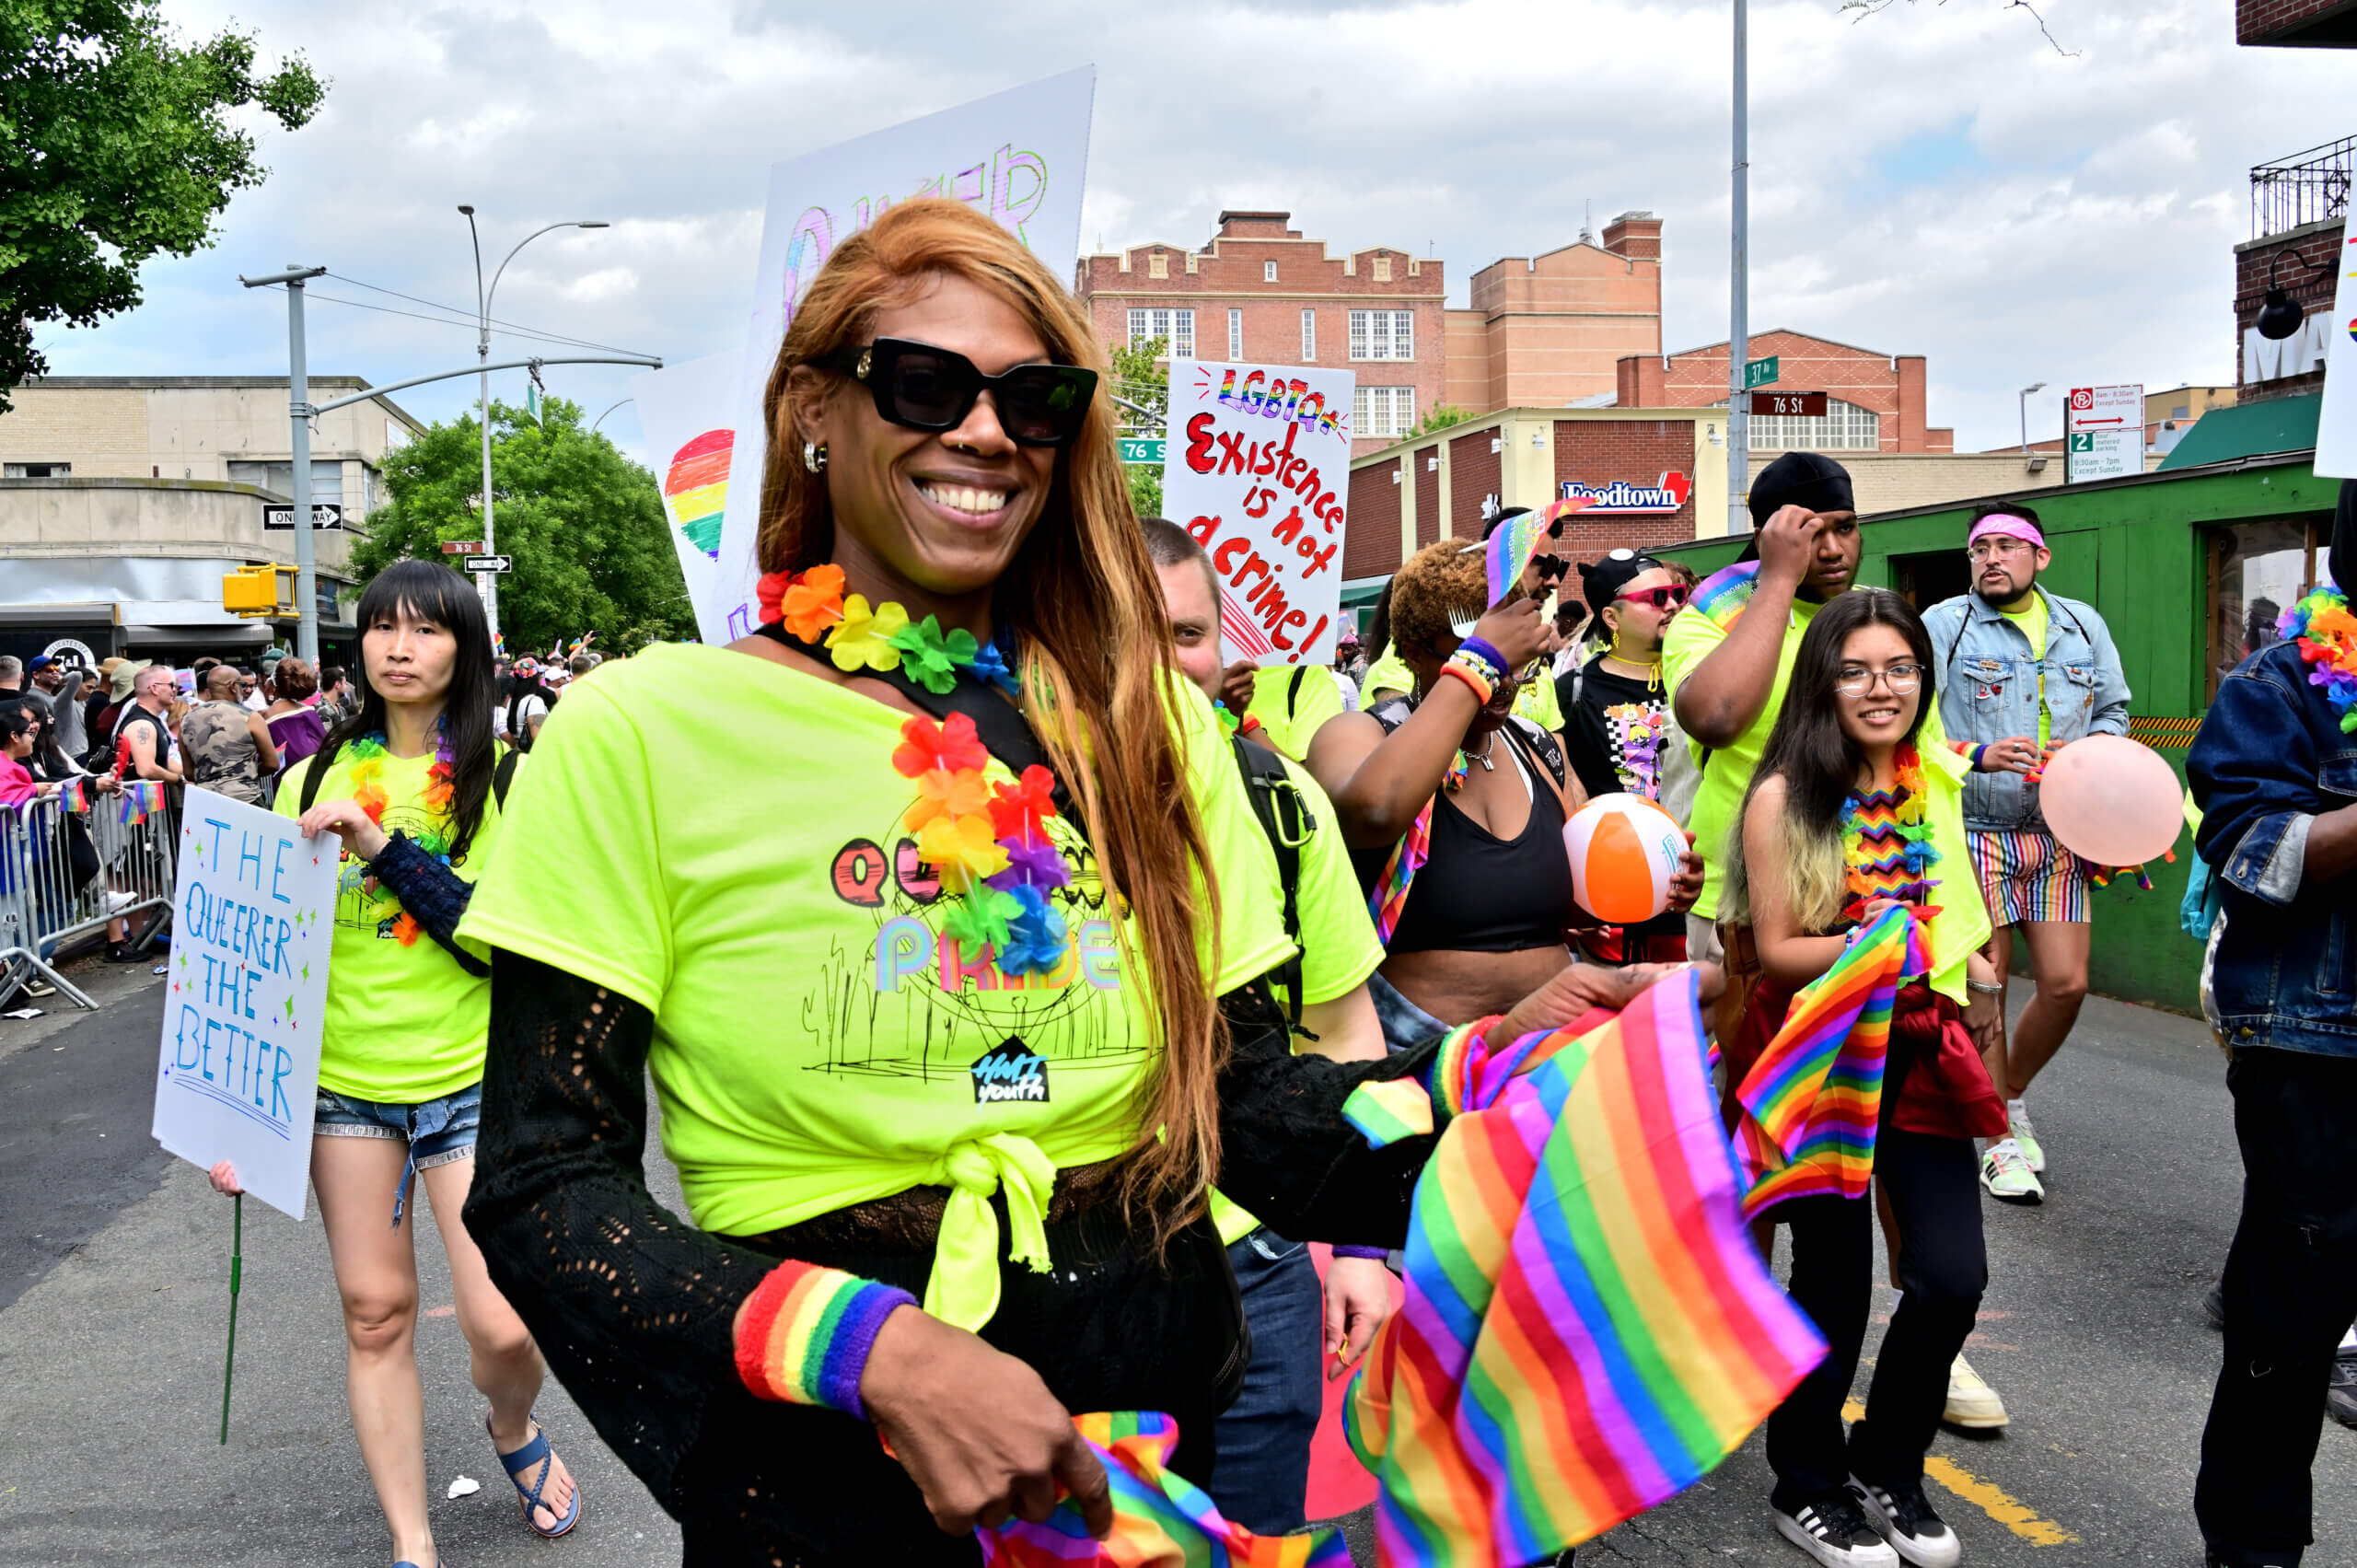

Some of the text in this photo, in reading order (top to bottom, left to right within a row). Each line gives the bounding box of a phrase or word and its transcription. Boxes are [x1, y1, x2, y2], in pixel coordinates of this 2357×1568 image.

[1752, 363, 1762, 384] 37
[1216, 368, 1340, 436] LGBTQ+
[1773, 397, 1804, 413] 76 St
[2096, 398, 2136, 408] Except Sunday
[1124, 443, 1167, 459] 76 S
[2076, 434, 2088, 451] 2
[1185, 412, 1344, 534] Existence
[2074, 465, 2123, 475] Except Sunday
[2106, 457, 2120, 466] 7pm
[1563, 482, 1676, 507] Foodtown
[275, 512, 295, 523] ON
[1242, 476, 1338, 579] is not
[455, 543, 472, 552] 76 St
[1185, 515, 1329, 664] a crime!
[203, 818, 294, 904] THE
[185, 881, 293, 981] QUEERER
[202, 952, 263, 1020] THE
[175, 1003, 294, 1122] BETTER
[976, 1074, 1046, 1112] youth
